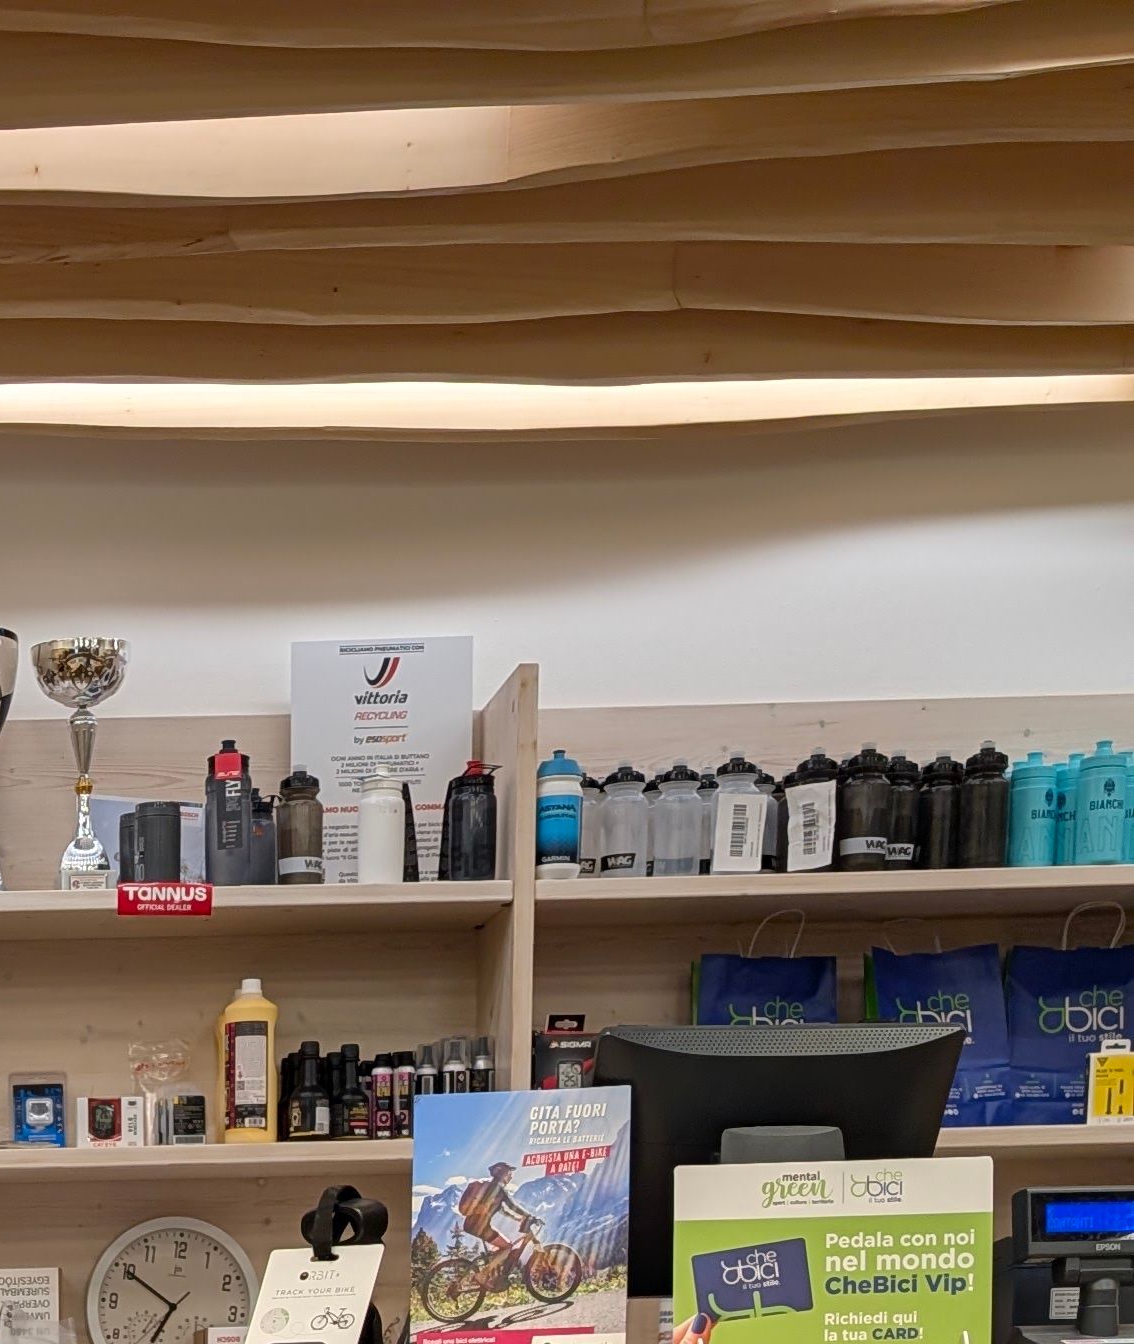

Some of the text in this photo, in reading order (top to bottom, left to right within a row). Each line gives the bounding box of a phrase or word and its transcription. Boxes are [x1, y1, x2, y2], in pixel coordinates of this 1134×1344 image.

[354, 690, 408, 705] vittoria
[354, 710, 408, 721] RECYCLING
[354, 733, 407, 745] by esosport
[225, 780, 242, 799] FLY
[538, 804, 576, 813] ASTANA
[541, 855, 571, 863] GARMIN
[607, 855, 632, 867] WAG
[123, 886, 207, 902] TANNUS
[137, 903, 192, 912] OFFICIAL DEALER
[928, 990, 969, 1009] che
[1079, 985, 1124, 1008] che
[765, 995, 804, 1019] che
[1066, 997, 1125, 1033] bici
[1078, 1034, 1097, 1042] tuo
[529, 1103, 607, 1121] GITA FUORI
[529, 1120, 581, 1136] PORTA?
[529, 1134, 605, 1145] RICARICA LE BATTERIE
[525, 1147, 608, 1165] ACQUISTA UNA E-BIKE
[549, 1162, 580, 1174] A RATE!
[782, 1171, 820, 1181] mental
[875, 1168, 903, 1181] che
[761, 1178, 833, 1208] green
[866, 1180, 903, 1197] bici
[825, 1229, 975, 1249] Pedala con noi
[1095, 1243, 1121, 1251] EPSON
[144, 1245, 156, 1264] 11
[173, 1240, 188, 1260] 12
[746, 1249, 777, 1264] che
[205, 1251, 211, 1270] 1
[825, 1248, 975, 1272] nel mondo
[122, 1262, 136, 1281] 10
[738, 1261, 780, 1284] bici
[222, 1274, 232, 1292] 2
[275, 1286, 355, 1296] TRACK YOUR BIKE
[749, 1282, 761, 1290] tuo
[825, 1274, 974, 1296] CheBici Vip!
[108, 1292, 119, 1310] 9
[227, 1305, 238, 1323] 3
[824, 1311, 918, 1327] Richiedi qui
[112, 1328, 120, 1340] 8
[216, 1336, 241, 1344] BOSCH
[824, 1327, 924, 1342] la tua CARD!
